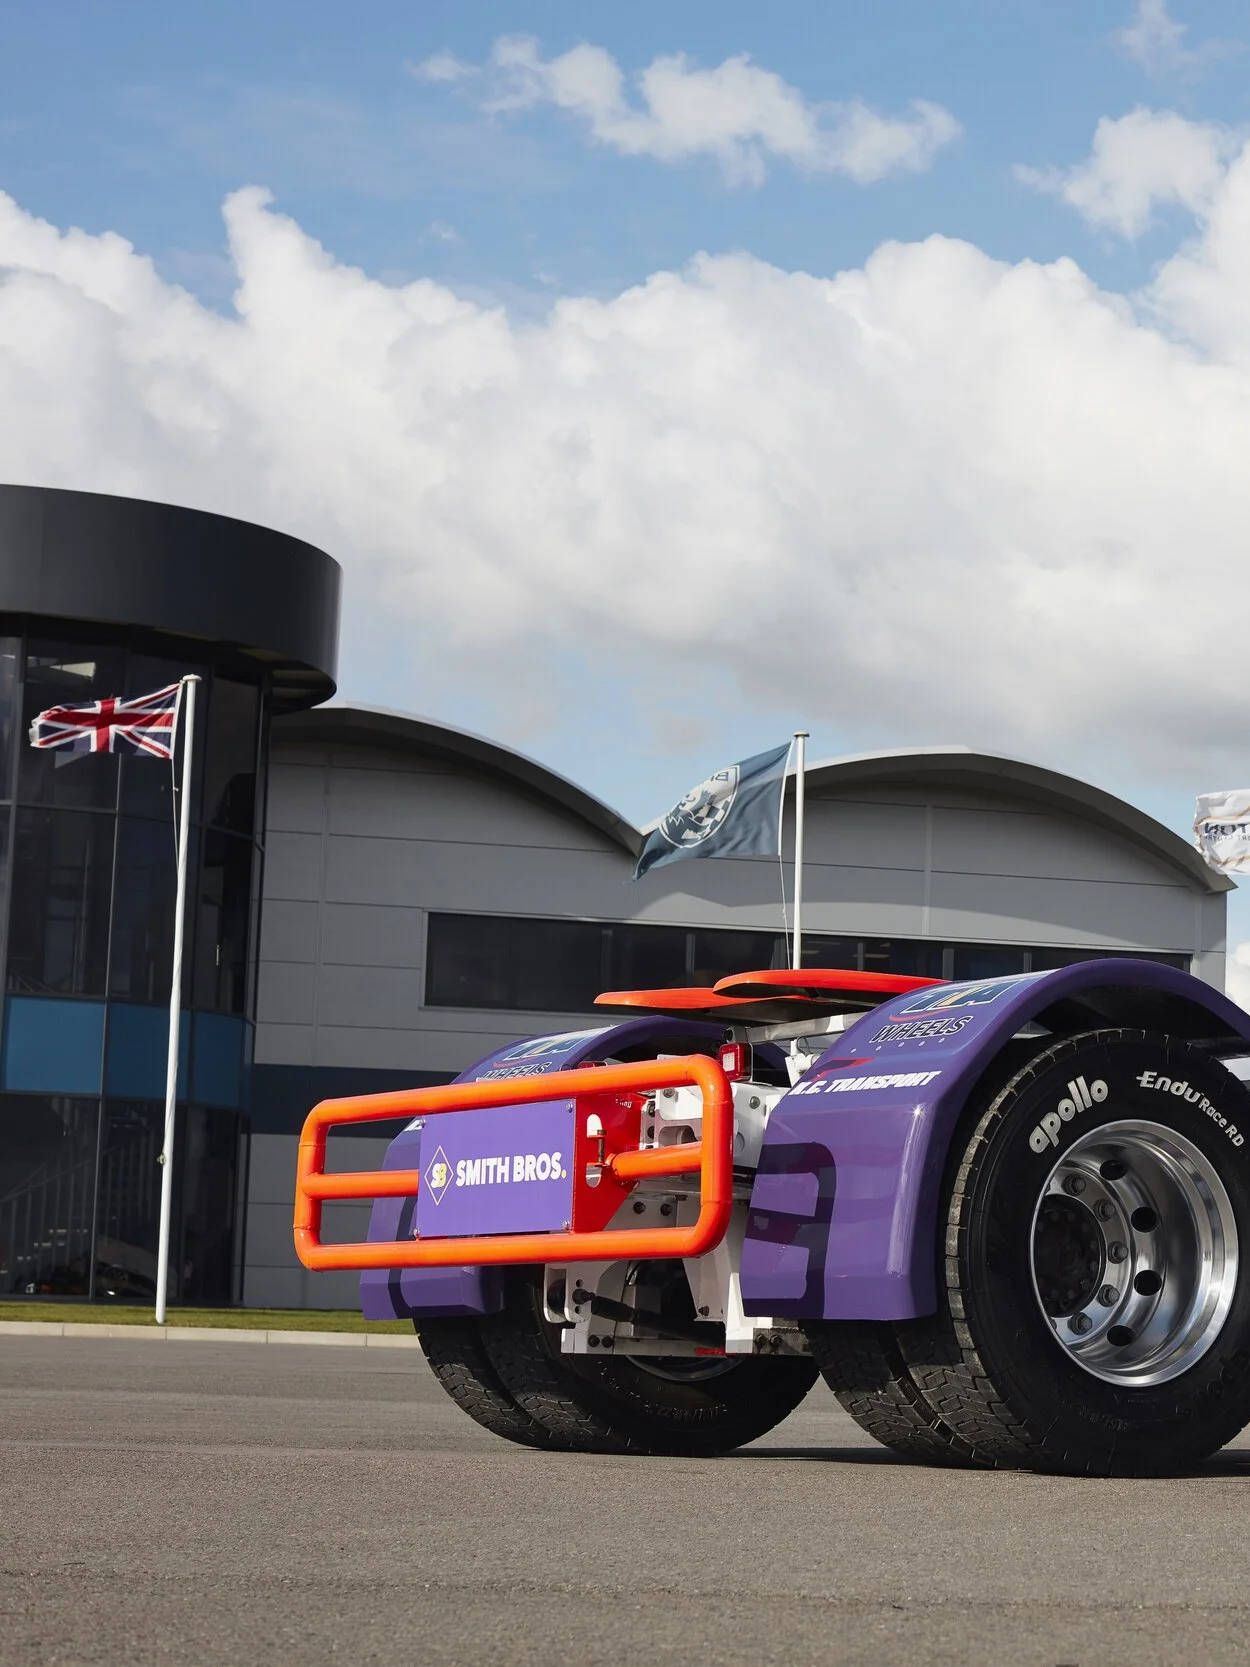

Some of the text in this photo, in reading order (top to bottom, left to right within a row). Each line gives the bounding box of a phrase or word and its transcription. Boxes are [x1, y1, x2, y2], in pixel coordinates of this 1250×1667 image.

[869, 1016, 973, 1044] WHEELS
[824, 1071, 942, 1093] TRANSPORT
[1029, 1075, 1109, 1153] apollo
[456, 1152, 567, 1187] SMITH BROS.
